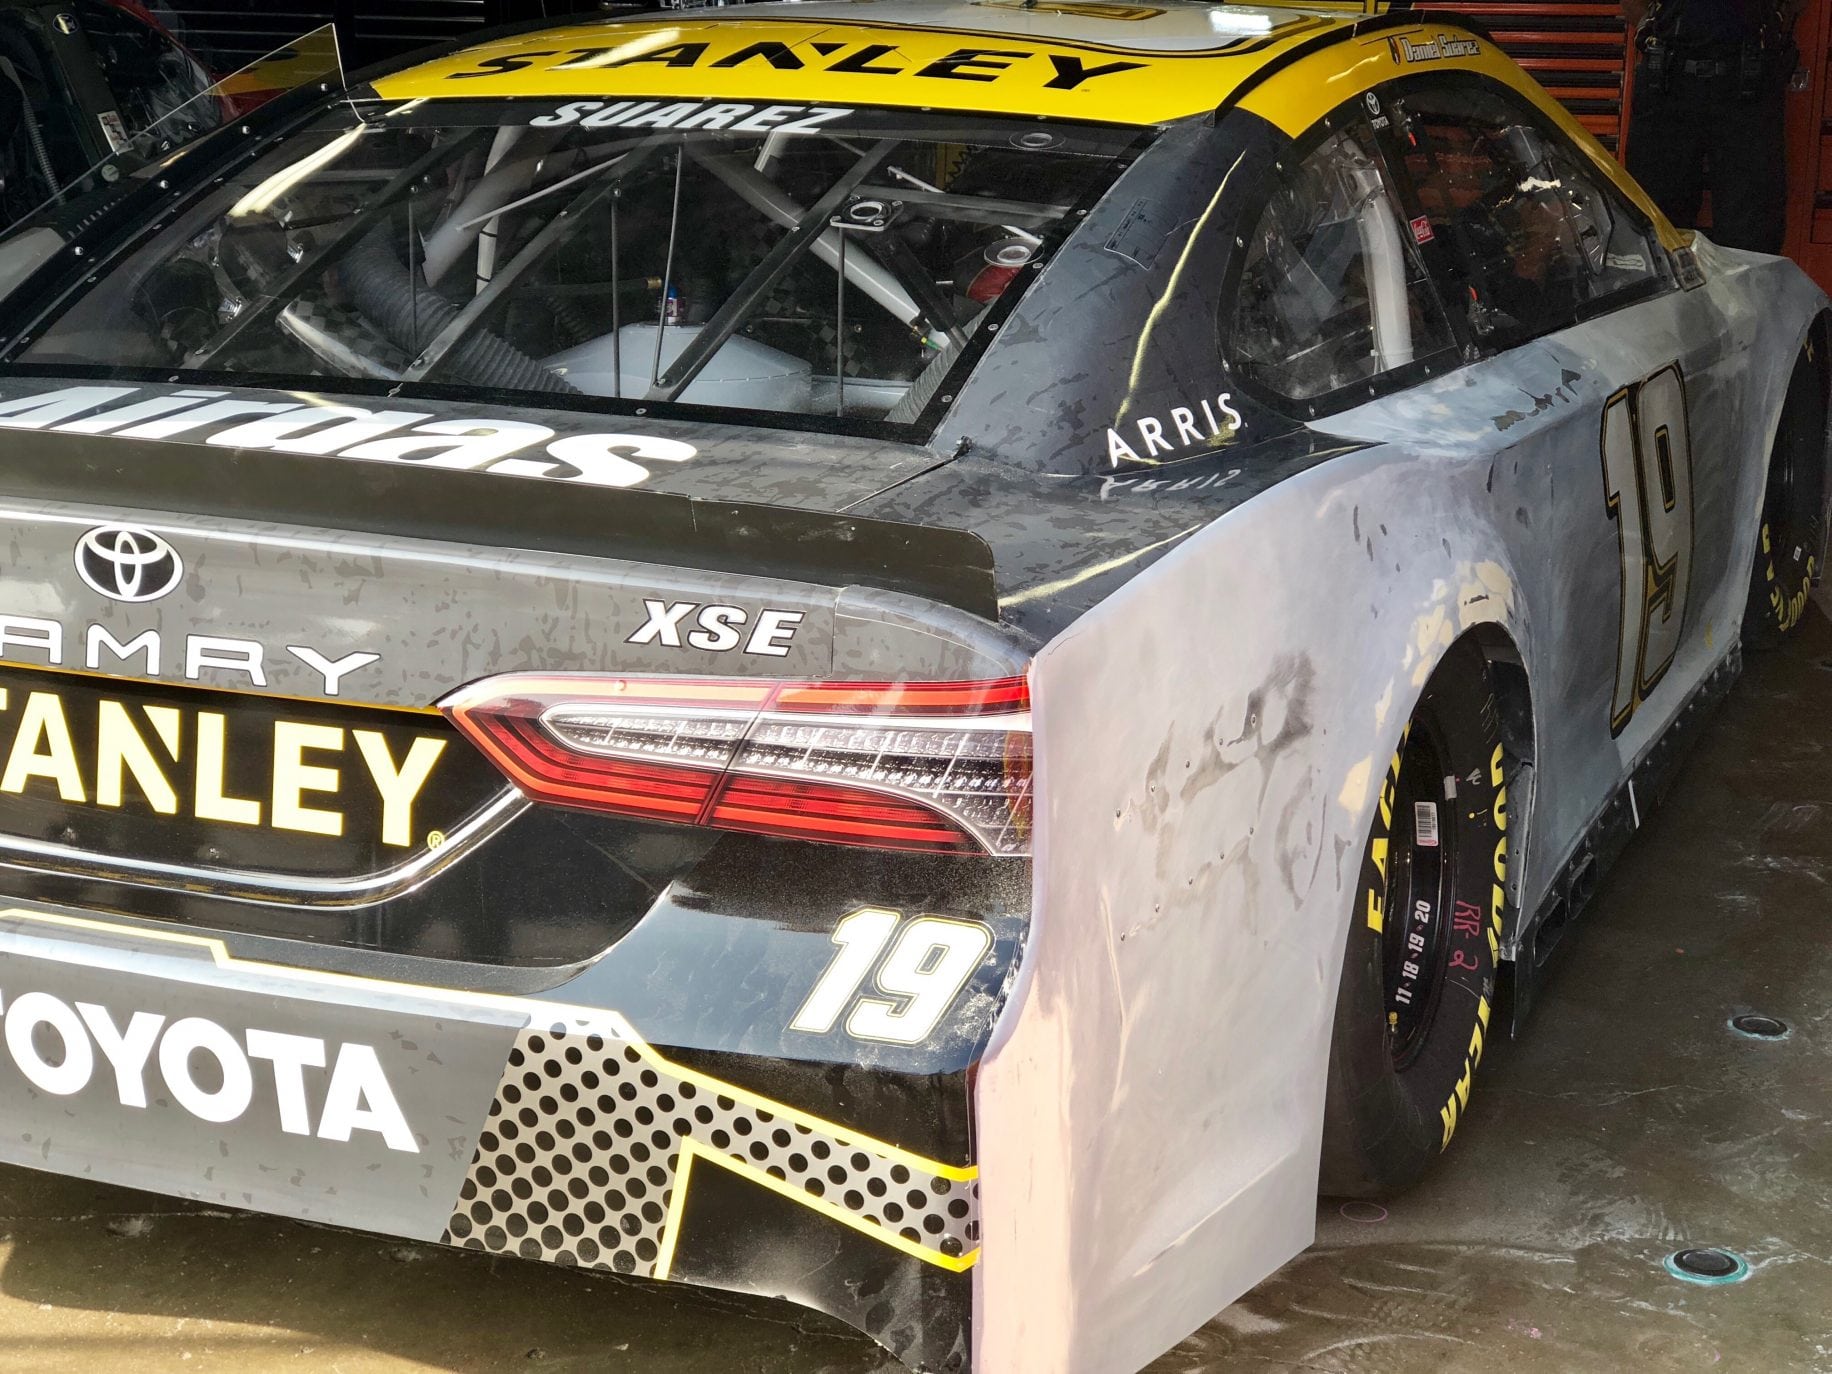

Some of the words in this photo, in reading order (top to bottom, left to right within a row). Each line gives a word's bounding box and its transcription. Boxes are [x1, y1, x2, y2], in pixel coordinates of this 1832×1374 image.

[448, 40, 1152, 92] STANLEY
[1399, 37, 1441, 62] Daniel
[530, 101, 855, 134] SUAREZ
[1106, 392, 1243, 469] ARRIS
[1601, 358, 1694, 740] 19
[626, 599, 805, 657] XSE
[788, 908, 995, 1045] 19
[0, 991, 420, 1153] OYOTA
